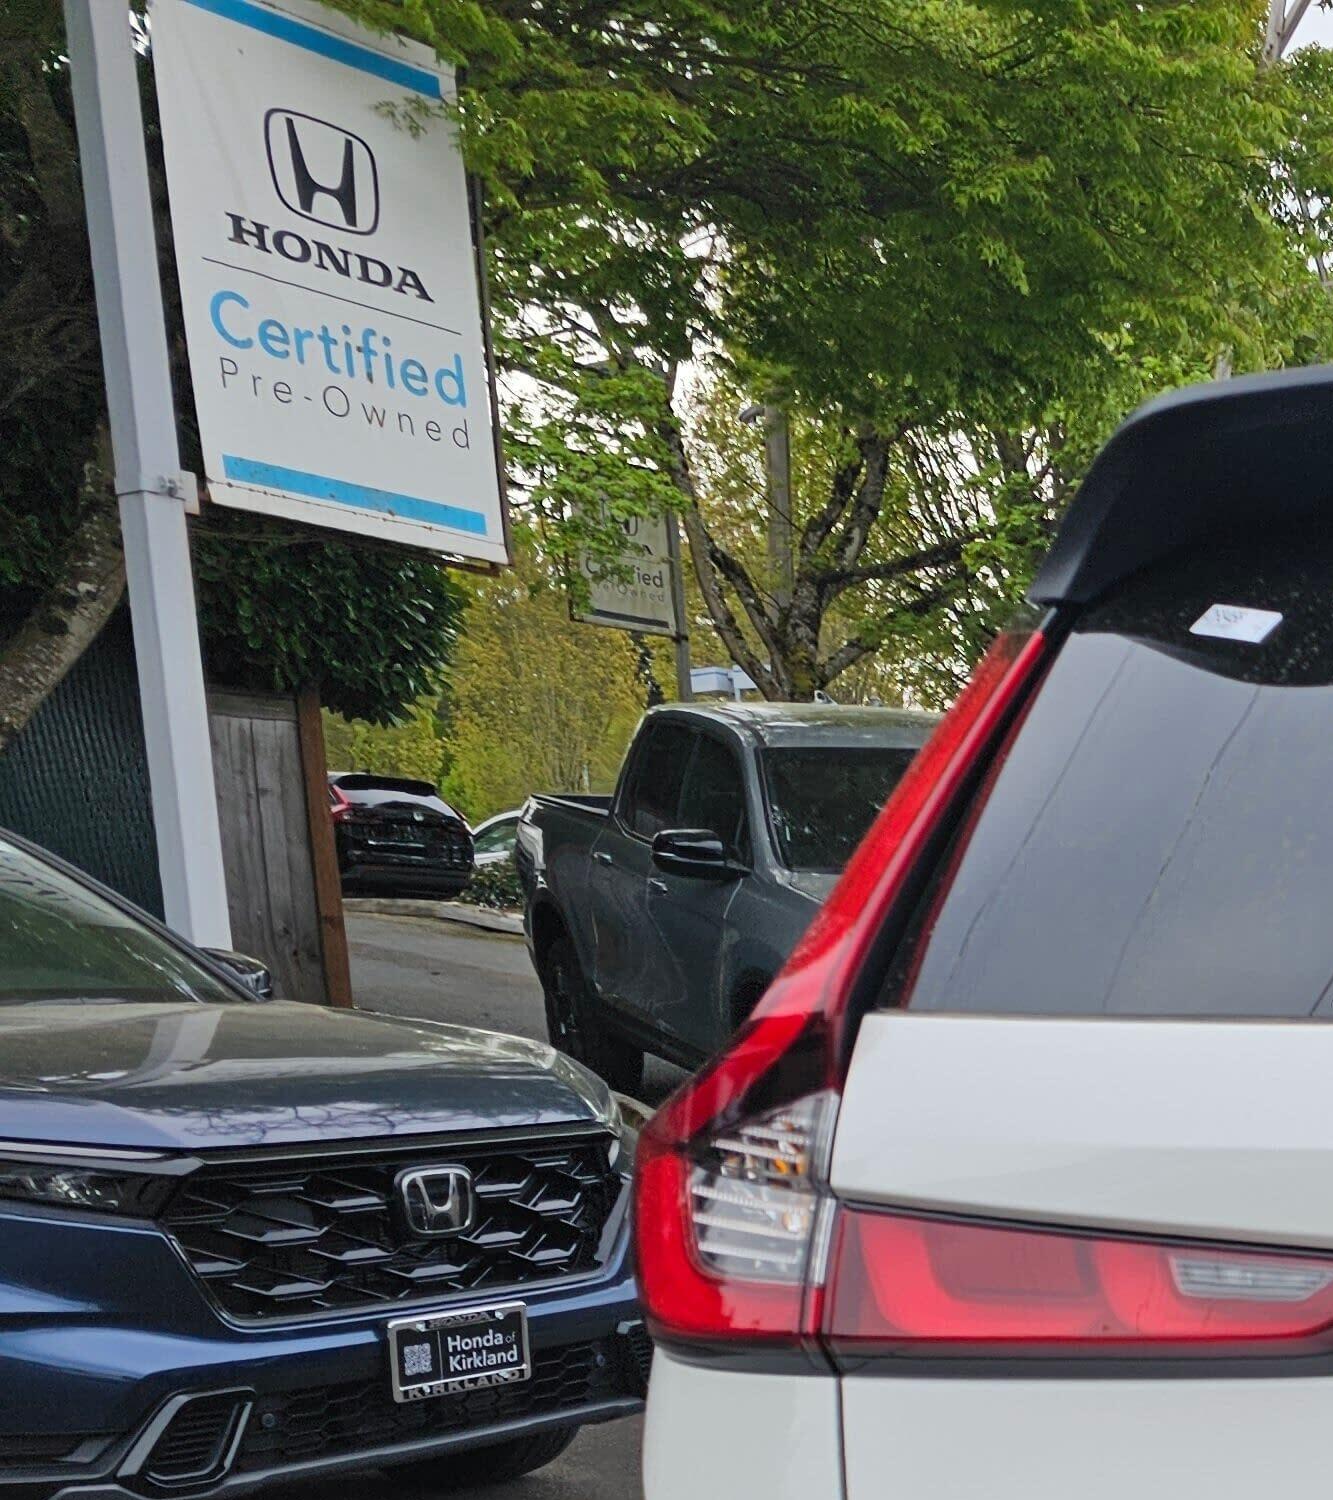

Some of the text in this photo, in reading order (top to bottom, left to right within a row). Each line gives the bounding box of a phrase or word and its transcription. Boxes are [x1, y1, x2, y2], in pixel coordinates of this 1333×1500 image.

[225, 211, 434, 303] HONDA
[210, 290, 467, 408] Certified
[219, 357, 470, 450] Pre-Owned
[447, 1328, 517, 1353] Honda of
[449, 1344, 518, 1372] Kirkland
